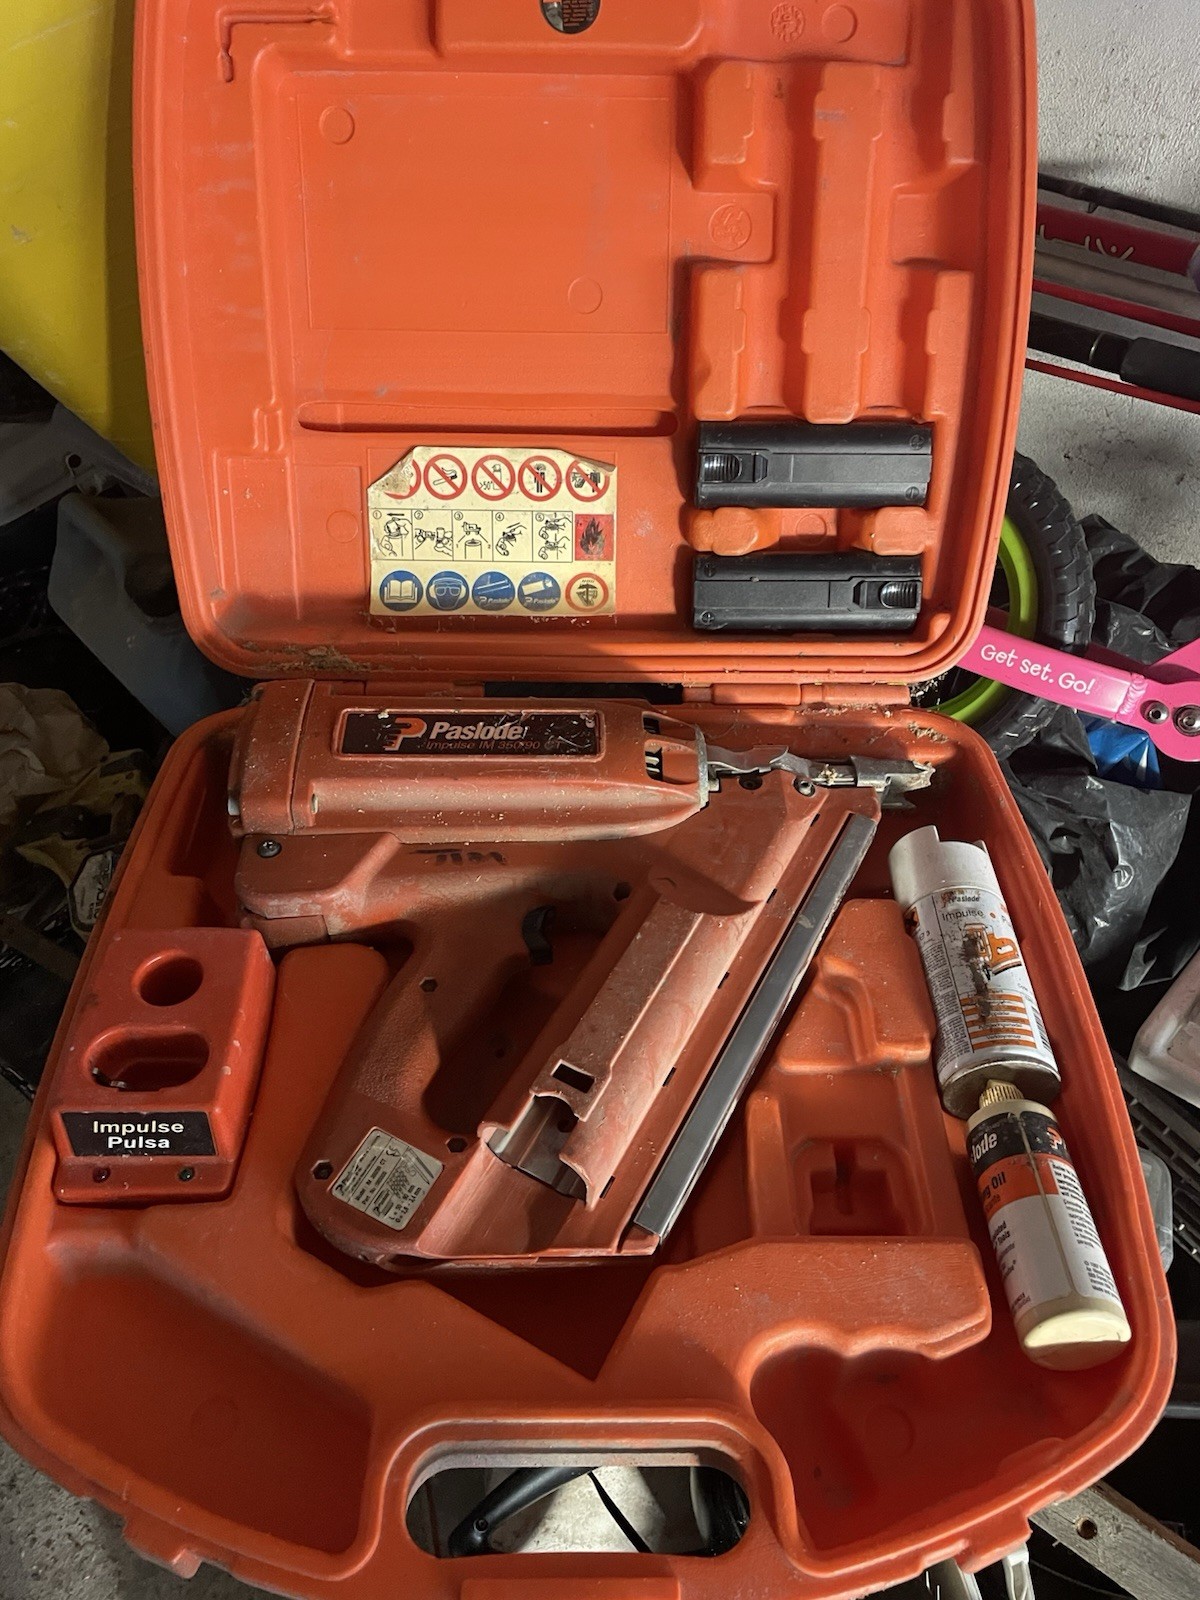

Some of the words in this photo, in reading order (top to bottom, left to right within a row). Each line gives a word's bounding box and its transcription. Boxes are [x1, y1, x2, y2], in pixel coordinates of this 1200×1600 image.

[981, 644, 1018, 668] Get
[1020, 658, 1054, 683] set.
[1058, 672, 1096, 695] Go!
[429, 722, 524, 740] Paslode
[426, 740, 476, 751] Impulse
[479, 741, 494, 749] IM
[942, 909, 984, 921] Impulse
[93, 1120, 184, 1135] Impulse
[107, 1136, 170, 1149] Pulsa
[992, 1171, 1006, 1189] Oil
